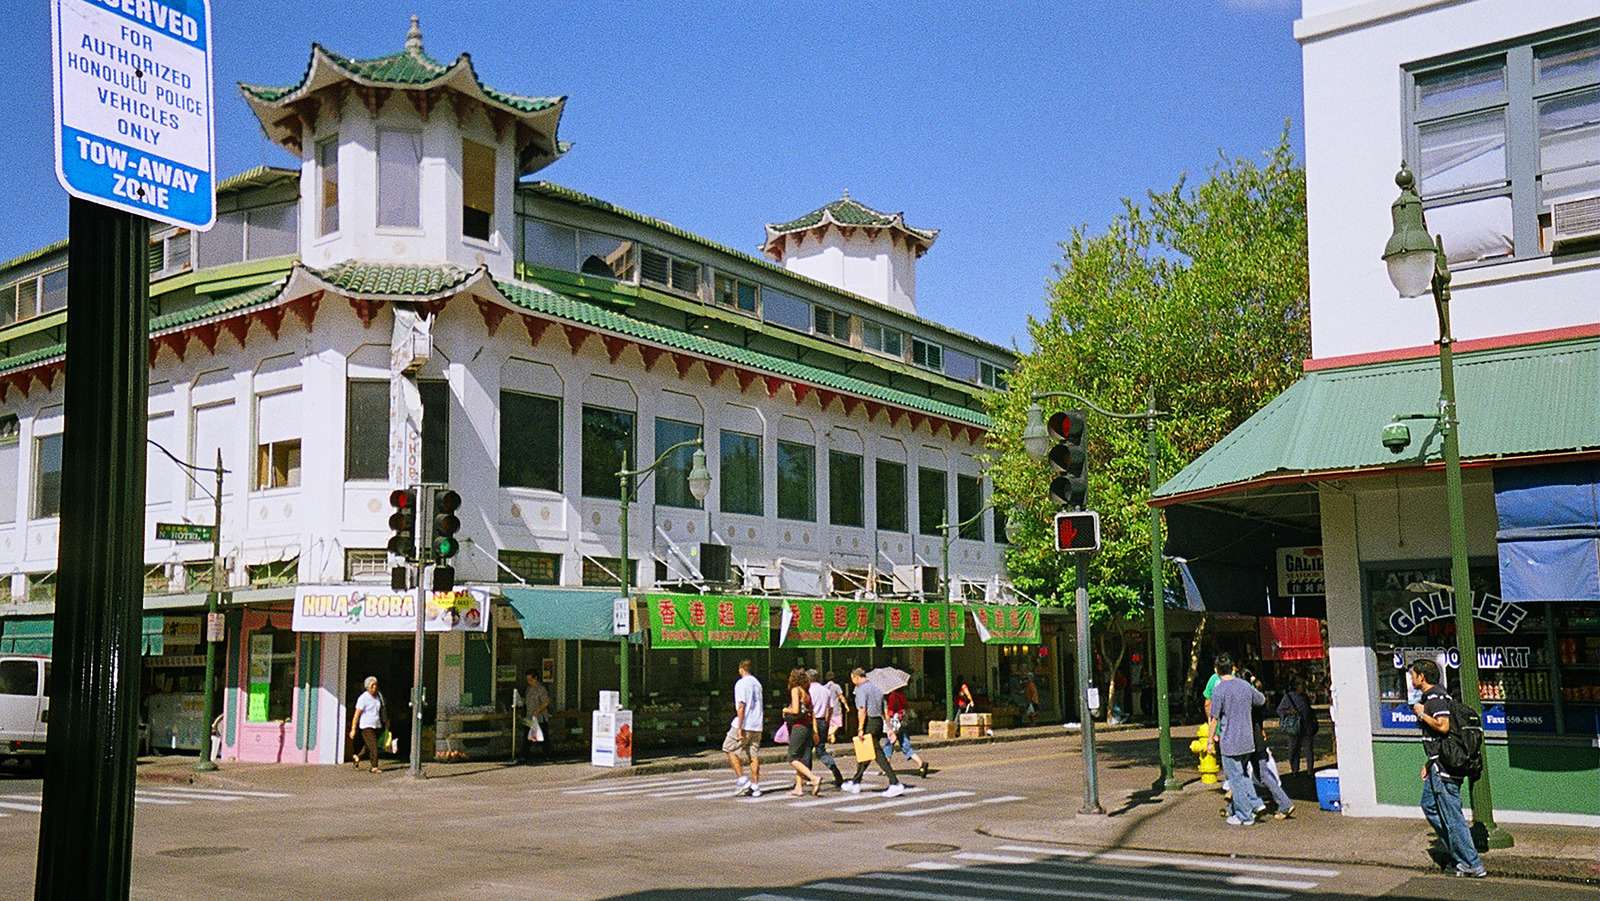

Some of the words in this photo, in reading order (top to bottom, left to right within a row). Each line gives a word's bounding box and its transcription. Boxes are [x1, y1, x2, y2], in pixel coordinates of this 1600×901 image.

[121, 25, 152, 51] FOR
[81, 34, 191, 89] AUTHORIZED
[68, 52, 147, 95] HONOLULU
[156, 86, 202, 116] POLICE
[97, 87, 179, 129] VEHICLES
[118, 118, 160, 146] ONLY
[76, 136, 199, 193] TOW-AWAY
[113, 174, 169, 210] ZONE
[171, 531, 201, 540] HOTEL
[1286, 554, 1325, 572] GALIL
[302, 594, 348, 617] HULA
[364, 594, 415, 617] BOBA
[658, 598, 761, 627] 香港超市
[1478, 646, 1530, 669] MART
[1391, 711, 1418, 723] Phon
